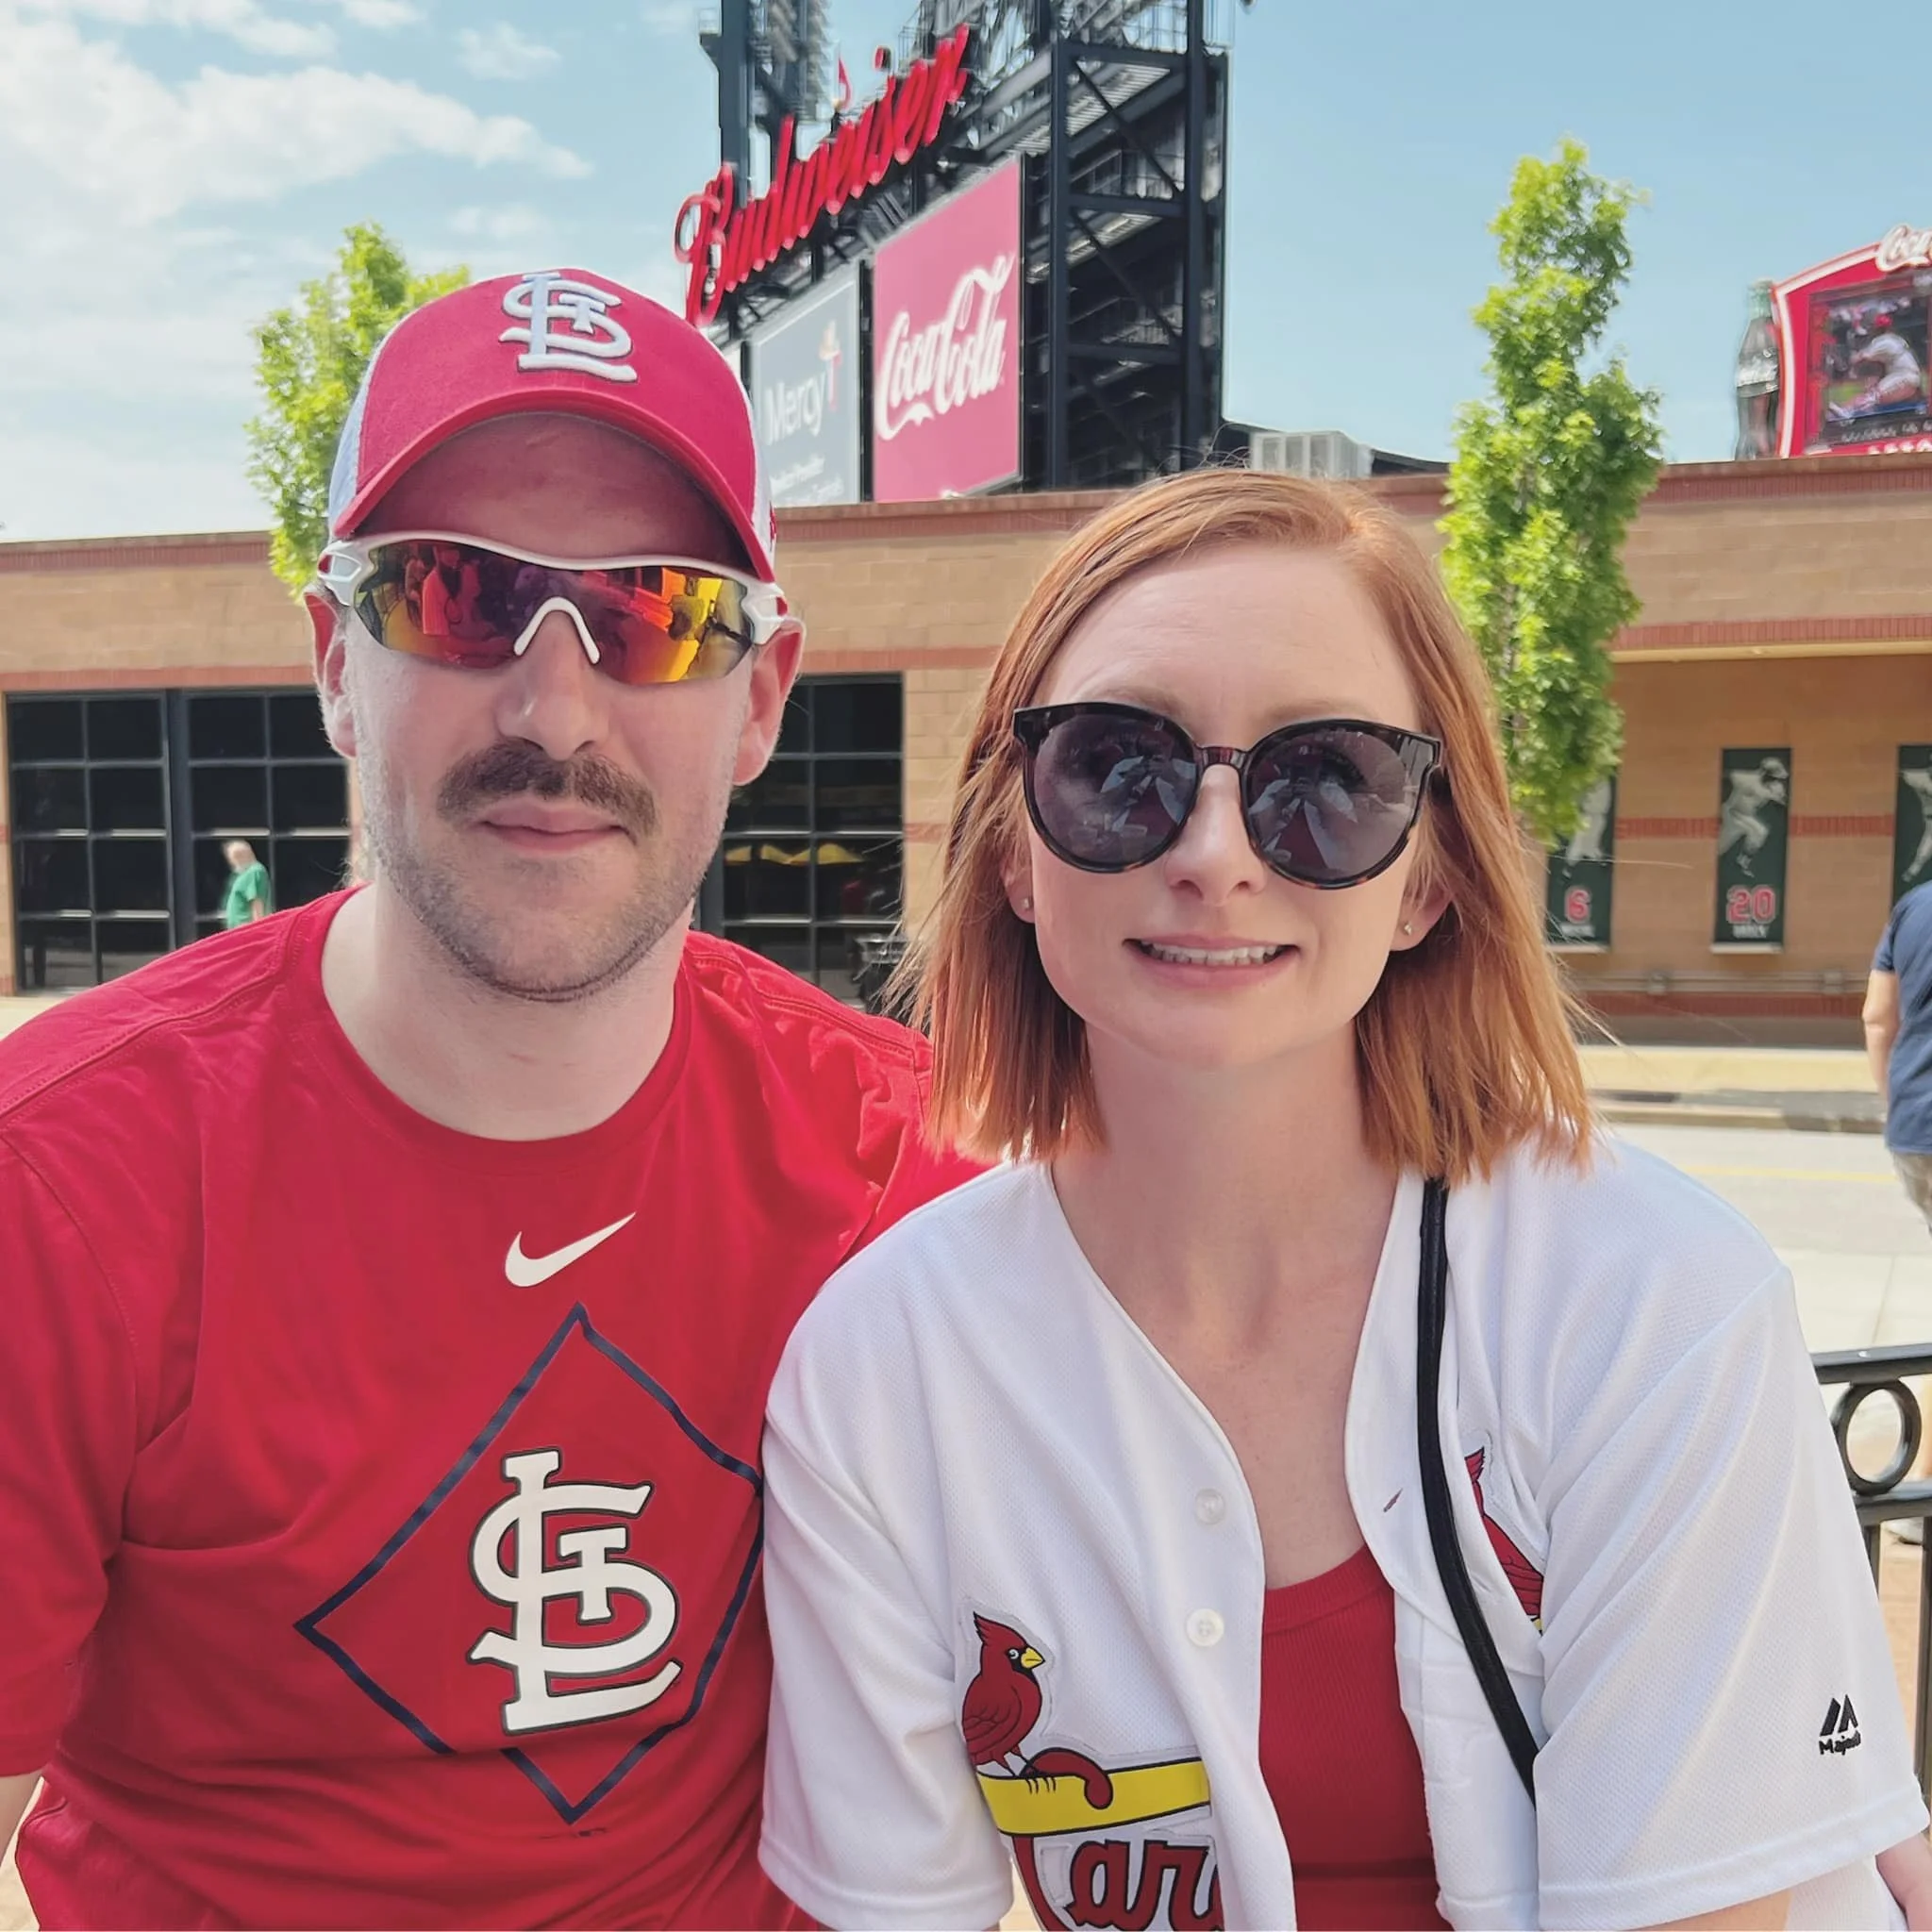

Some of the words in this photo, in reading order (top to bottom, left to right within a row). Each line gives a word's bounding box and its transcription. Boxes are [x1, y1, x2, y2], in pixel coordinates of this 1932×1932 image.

[674, 23, 970, 326] Budweiser
[764, 371, 826, 446] Mercy
[1564, 885, 1592, 924] 6
[1726, 884, 1776, 924] 20
